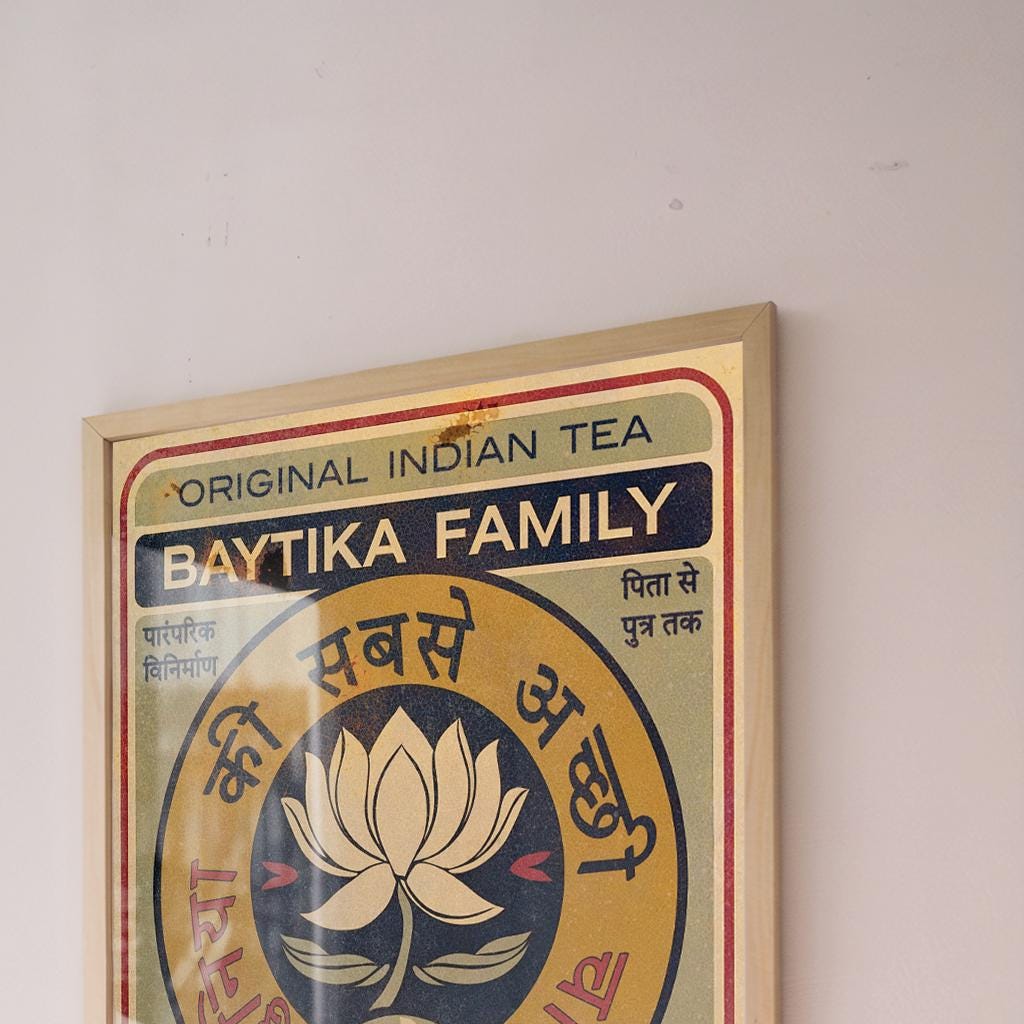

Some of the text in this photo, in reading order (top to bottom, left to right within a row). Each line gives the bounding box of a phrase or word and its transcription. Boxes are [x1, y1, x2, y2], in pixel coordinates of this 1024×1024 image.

[180, 414, 653, 508] ORIGINAL INDIAN TEA
[163, 482, 677, 591] BAYTIKA FAMILY
[621, 561, 700, 601] पिता से
[143, 616, 217, 647] पारंपरिक
[621, 609, 703, 648] पुत्र तक
[143, 649, 218, 682] विनिर्माण
[203, 700, 283, 804] की
[296, 585, 475, 698] सबसे
[516, 663, 657, 882] अच्छी
